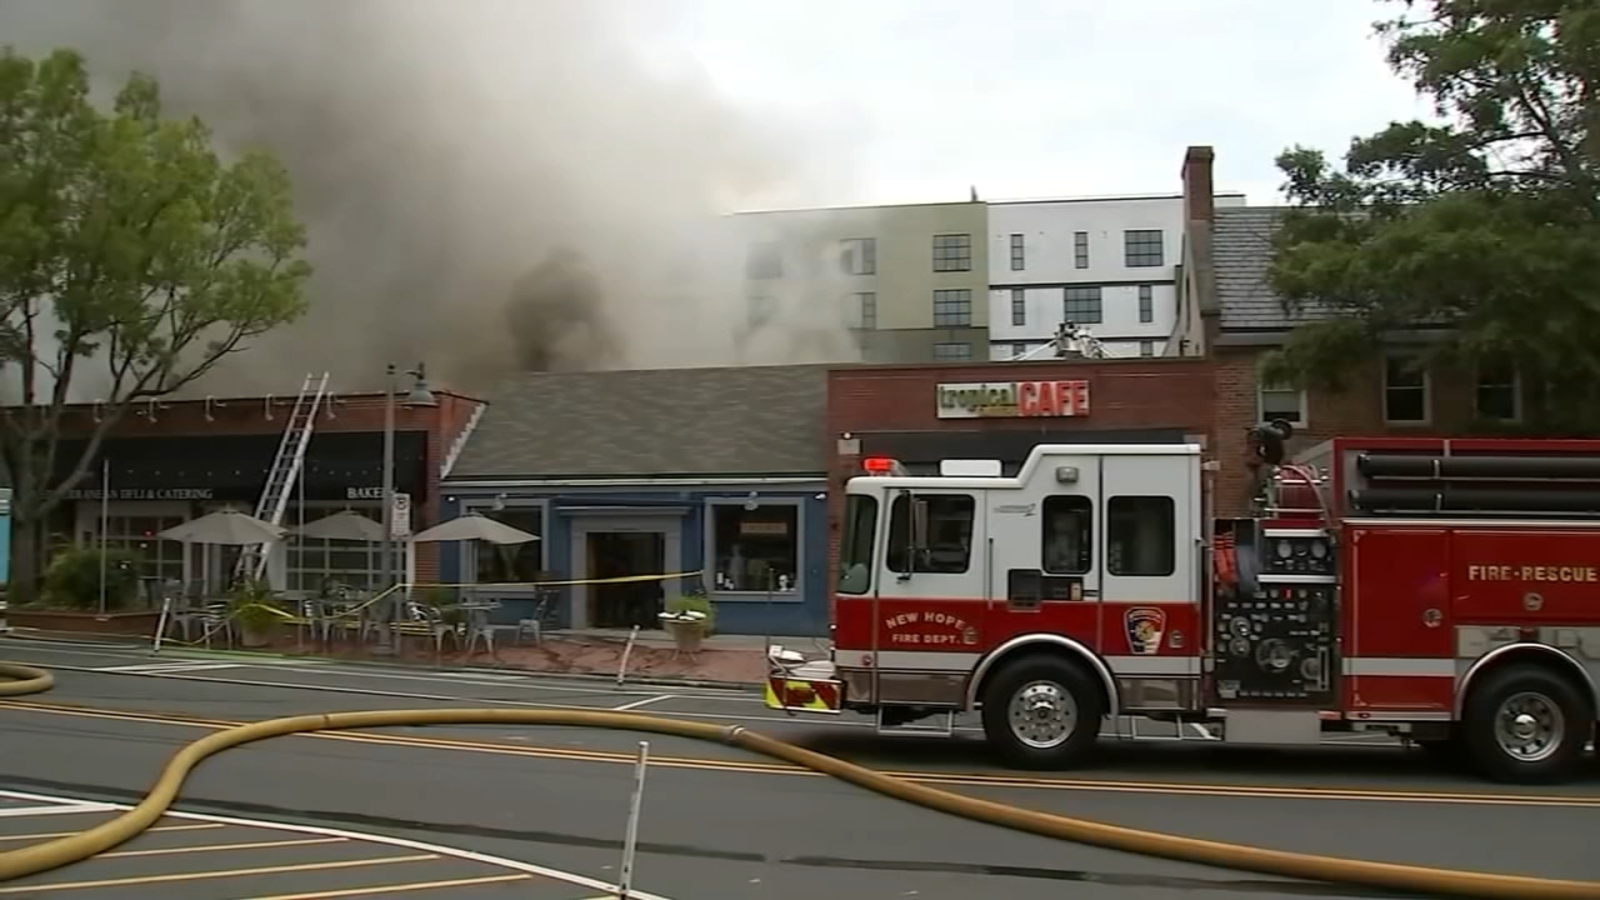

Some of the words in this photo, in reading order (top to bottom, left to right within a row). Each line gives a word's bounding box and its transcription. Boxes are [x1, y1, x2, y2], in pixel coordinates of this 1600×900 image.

[940, 383, 1017, 412] tropical
[1020, 381, 1089, 415] CAFE
[120, 489, 147, 499] DELI
[156, 489, 213, 499] CATERING
[347, 487, 397, 499] BAKE
[885, 612, 918, 629] NEW
[924, 611, 966, 630] HOPE
[892, 633, 920, 643] FIRE
[923, 634, 961, 644] DEPT.
